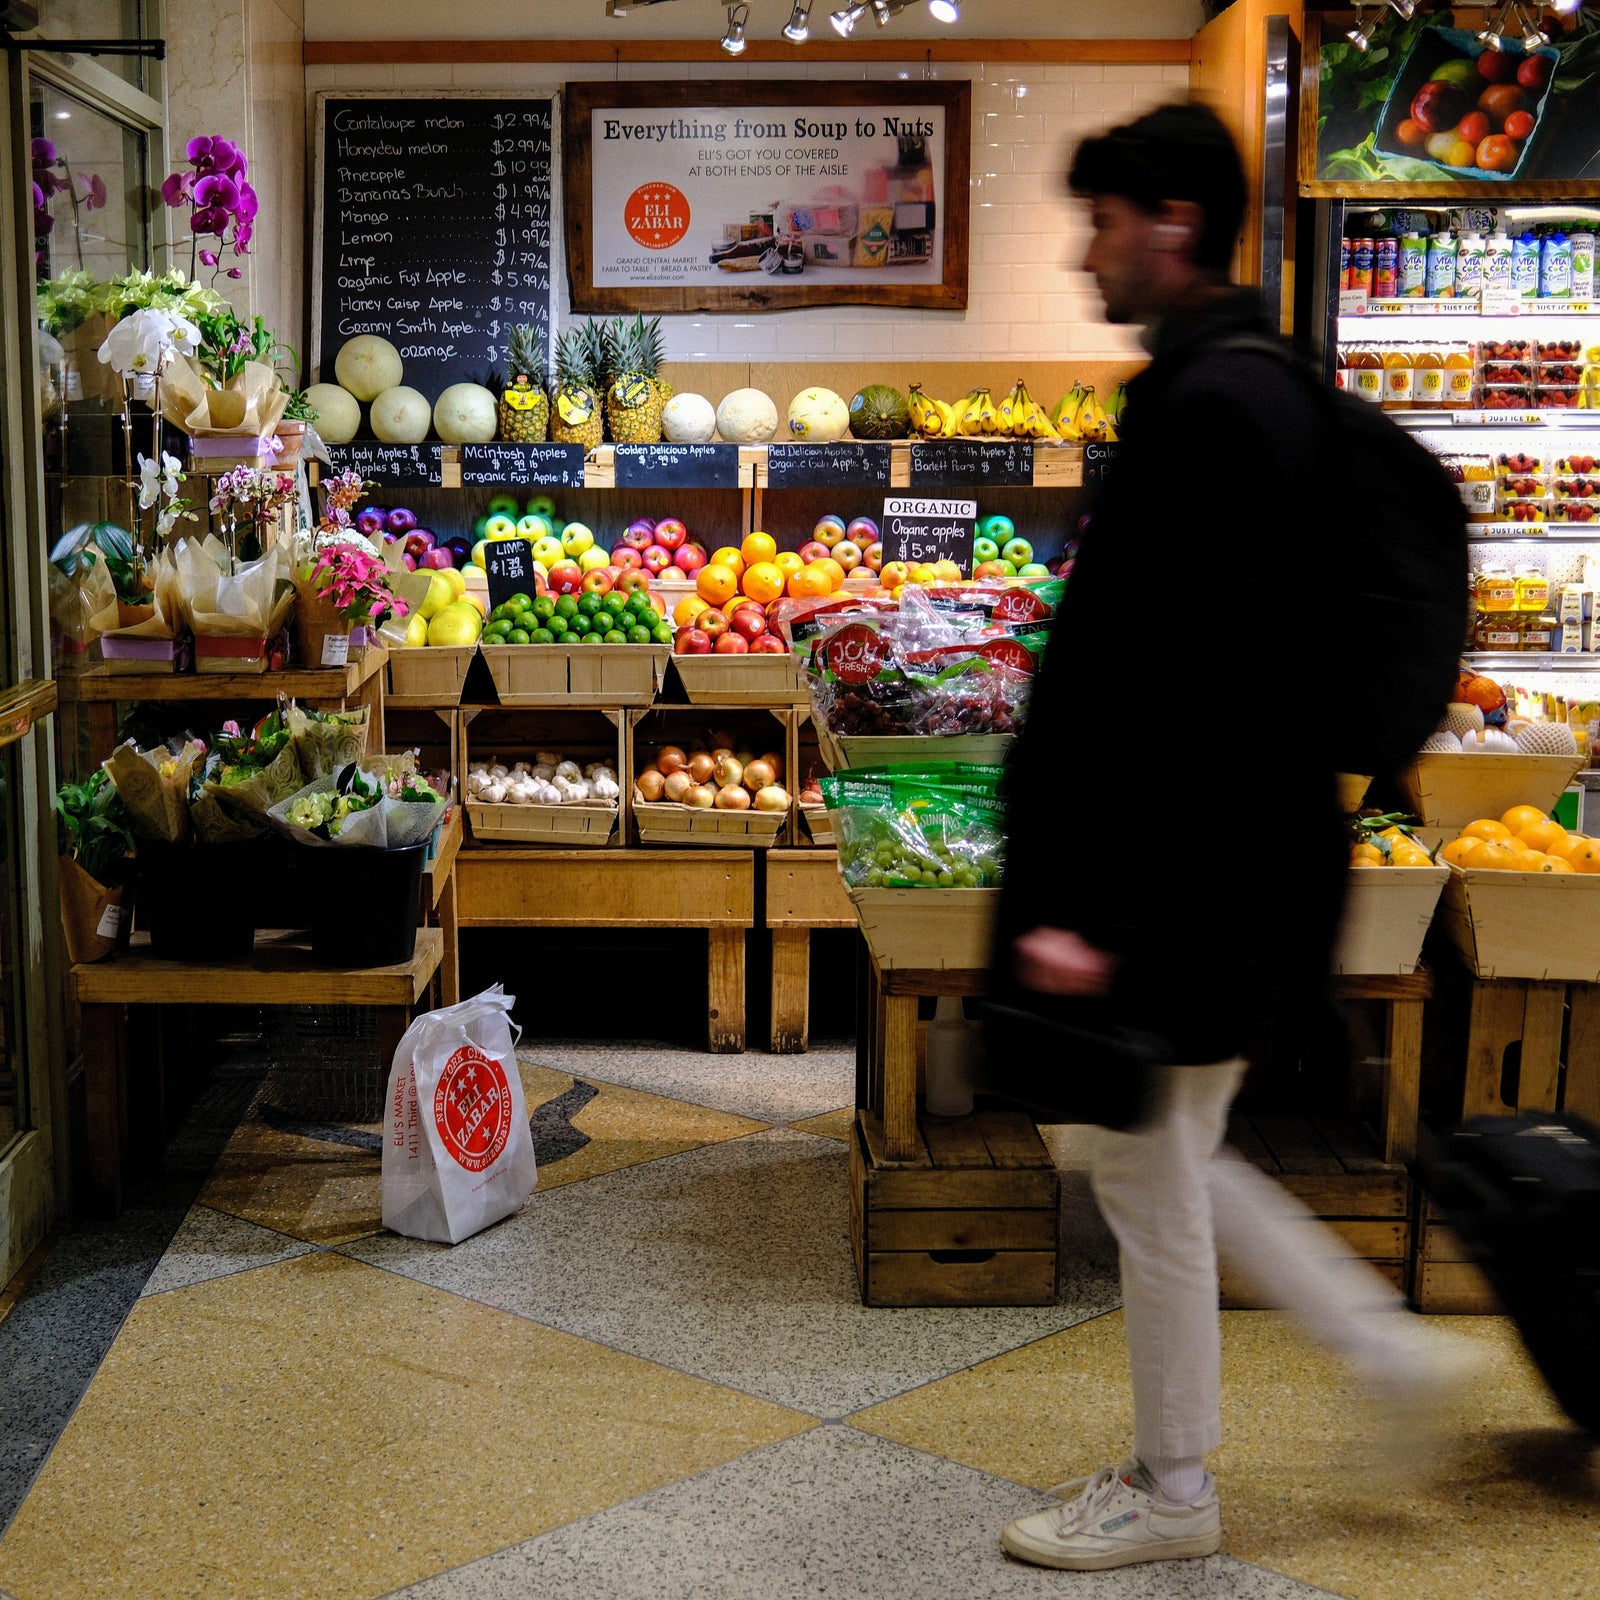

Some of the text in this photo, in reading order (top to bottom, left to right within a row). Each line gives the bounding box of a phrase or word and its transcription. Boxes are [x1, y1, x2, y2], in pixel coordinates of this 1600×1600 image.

[334, 110, 415, 132] Cantaloupe
[425, 115, 465, 129] melon
[603, 117, 934, 142] Everything from Soup to Nuts
[337, 138, 402, 158] Honeydew
[408, 142, 448, 154] melon
[698, 148, 839, 161] ELI'S GOT YOU COVERED
[338, 168, 405, 184] Pineapple
[688, 164, 848, 177] AT BOTH ENDS OF THE AISLE
[338, 188, 411, 203] Bananas
[413, 183, 463, 198] Bunch
[341, 209, 388, 224] Mango
[645, 204, 670, 217] ELI
[631, 216, 683, 230] ZABAR
[341, 230, 393, 246] Lemon
[1405, 256, 1422, 264] VITA
[1436, 256, 1452, 265] VITA
[1464, 256, 1480, 266] VITA
[1492, 256, 1508, 265] VITA
[1519, 256, 1535, 265] VITA
[1550, 256, 1566, 265] VITA
[661, 265, 682, 273] BREAD
[690, 265, 713, 273] PASTRY
[399, 269, 420, 287] Fuji
[426, 268, 466, 287] Apple
[340, 298, 381, 312] Honey
[429, 297, 463, 312] Apple
[397, 317, 436, 334] Smith
[442, 320, 473, 338] Apple
[325, 446, 347, 460] Pink
[352, 447, 373, 462] lady
[377, 447, 408, 461] Apples
[531, 447, 567, 461] Apples
[616, 444, 716, 458] Golden Delicious Apples
[768, 445, 786, 457] Red
[980, 446, 1006, 458] Apples
[354, 461, 386, 477] Apples
[769, 460, 806, 473] Orgac
[533, 472, 558, 485] Apple
[889, 501, 971, 515] ORGANIC
[891, 518, 965, 543] Organic apples
[496, 541, 525, 555] LIME
[839, 662, 868, 673] FRESH
[978, 796, 1007, 812] IMPAC
[409, 1085, 417, 1096] @
[436, 1050, 463, 1123] NEW YORK
[457, 1083, 482, 1119] ELI
[393, 1076, 406, 1147] ELI'S MARKET
[408, 1100, 418, 1128] Third
[457, 1086, 499, 1148] ZABAR
[408, 1134, 418, 1160] 1411
